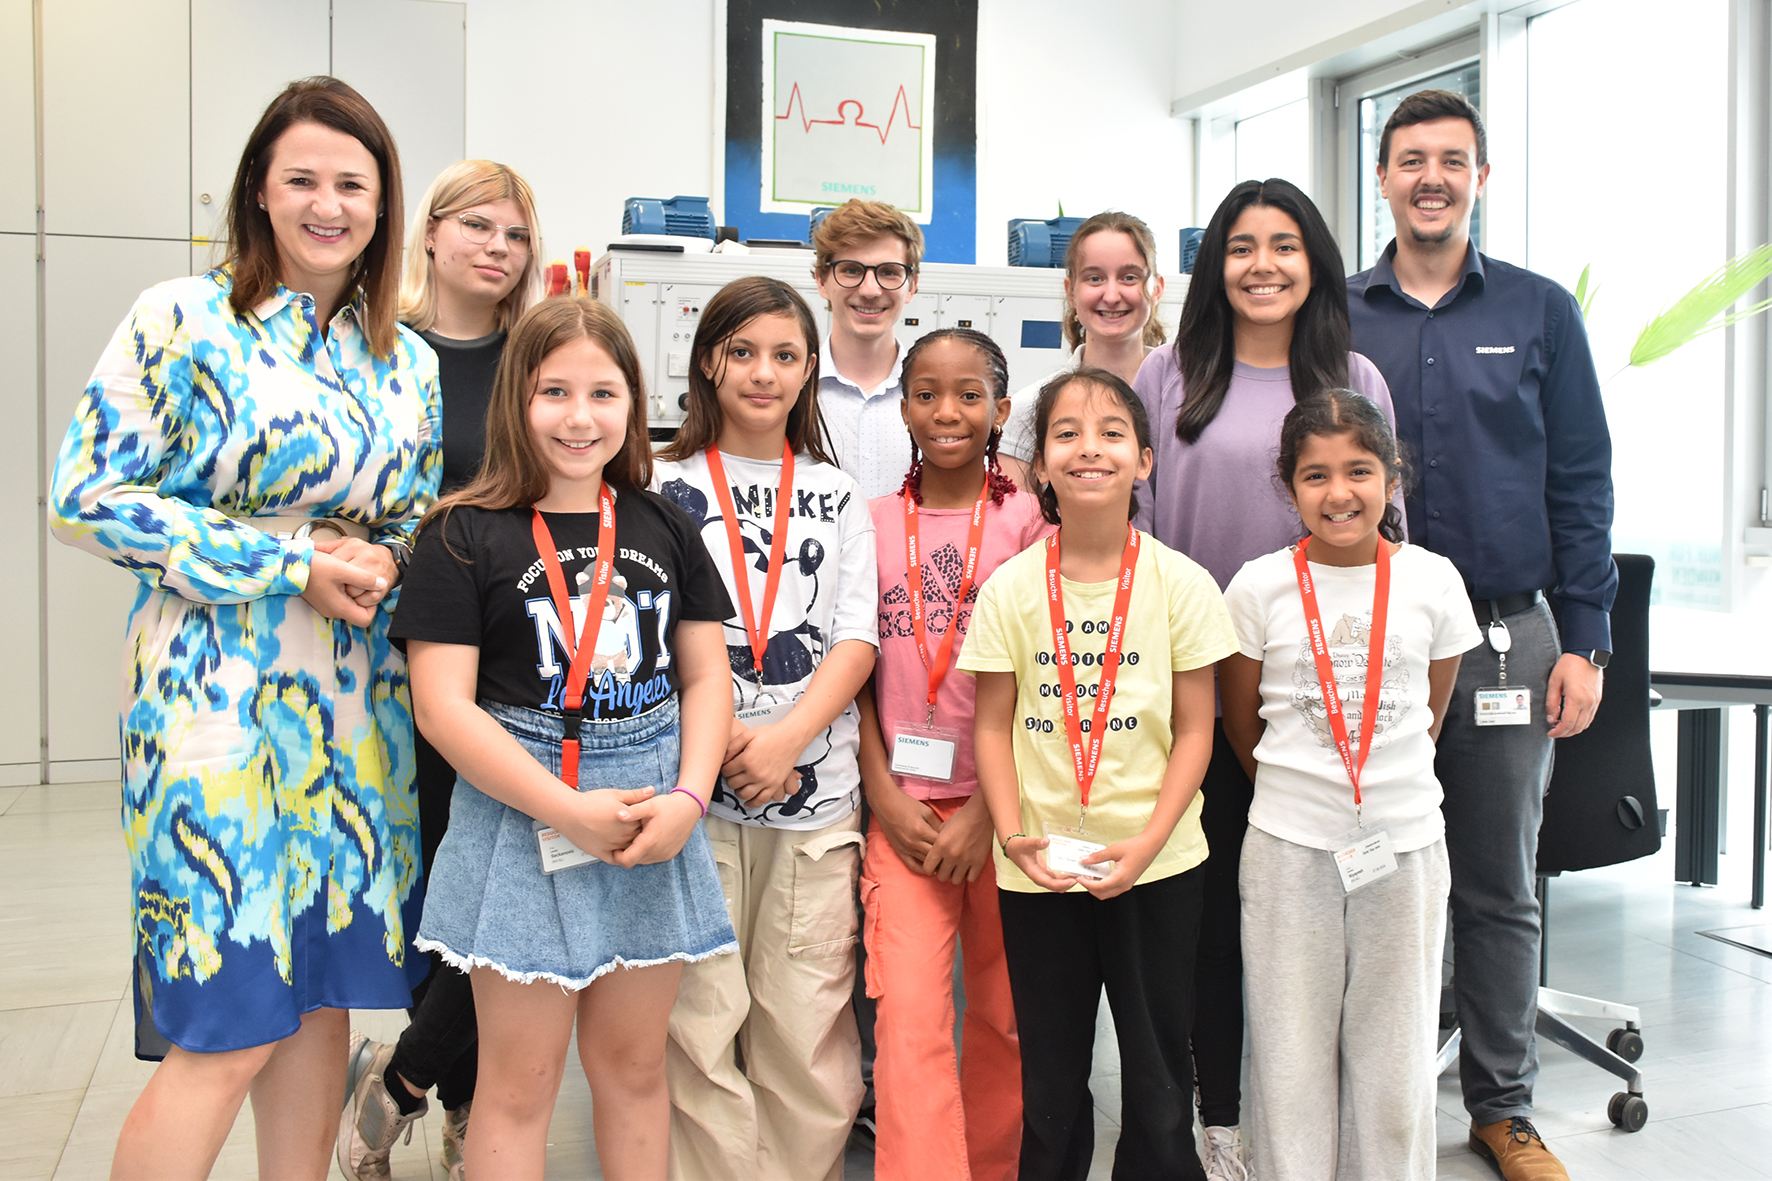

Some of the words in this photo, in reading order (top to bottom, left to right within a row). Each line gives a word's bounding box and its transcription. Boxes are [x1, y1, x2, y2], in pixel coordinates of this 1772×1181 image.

[822, 181, 876, 195] SIEMENS
[1475, 346, 1515, 354] SIEMENS
[602, 496, 613, 528] SIEMENS
[731, 484, 851, 523] MIKEY
[517, 560, 547, 593] FOCU
[557, 549, 573, 563] ON
[577, 547, 600, 559] YOU
[619, 548, 669, 584] DREAMS
[598, 561, 609, 585] Visitor
[966, 547, 977, 579] SIEMENS
[1121, 568, 1132, 590] Visitor
[1049, 569, 1058, 601] Besucher
[1302, 572, 1311, 594] Visitor
[878, 601, 972, 639] add
[1083, 621, 1109, 633] AM
[1110, 616, 1123, 653] SIEMENS
[1056, 627, 1068, 666] SIEMENS
[1311, 619, 1324, 655] SIEMENS
[1036, 653, 1139, 665] RATIG
[1040, 684, 1062, 697] MY
[1077, 684, 1115, 697] OW
[1065, 692, 1074, 717] Visitor
[1098, 679, 1112, 713] Besucher
[1326, 681, 1338, 714] Besucher
[738, 708, 771, 720] SIEMENS
[1347, 710, 1362, 719] and
[898, 737, 929, 747] SIEMENS
[1088, 739, 1100, 776] SIEMENS
[1073, 744, 1084, 782] SIEMENS
